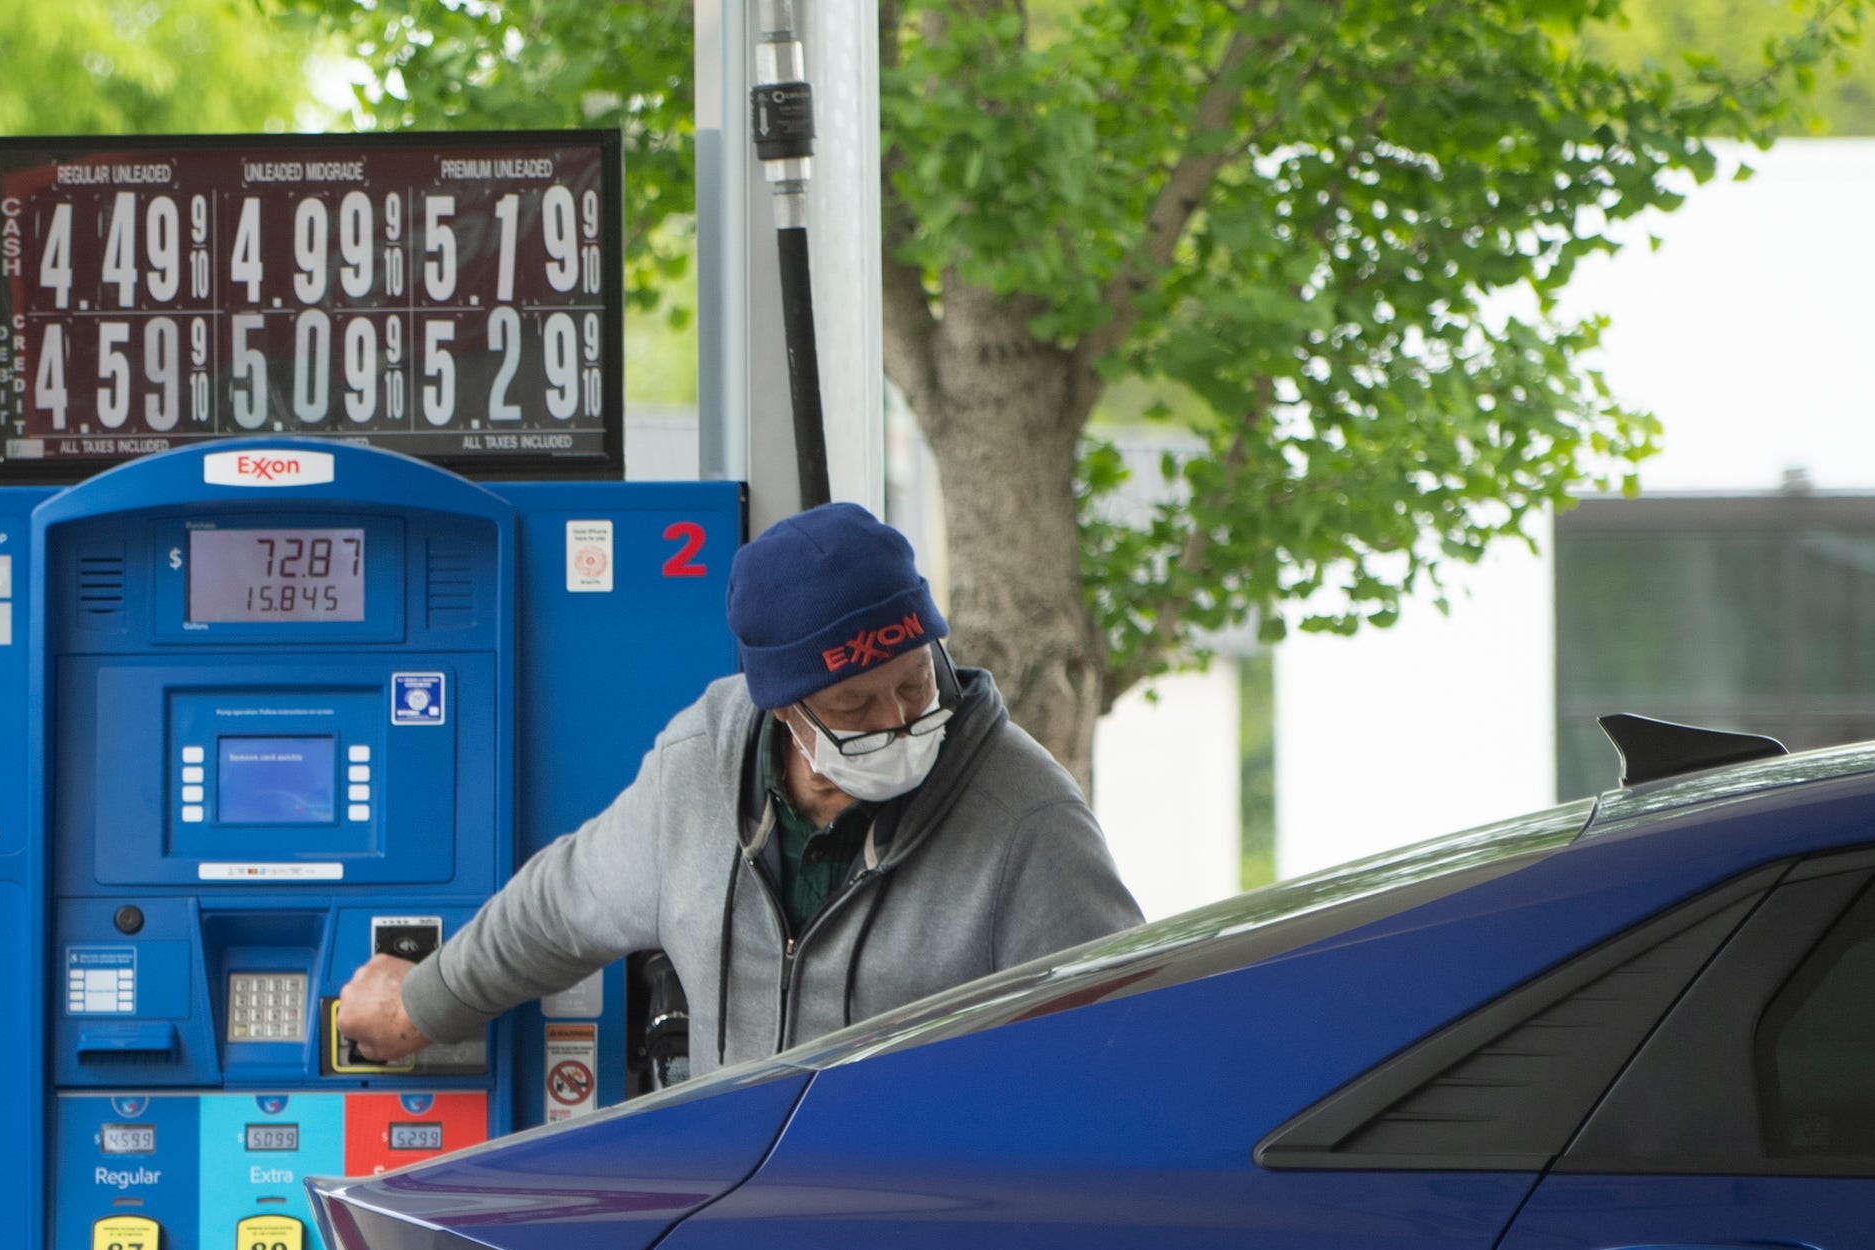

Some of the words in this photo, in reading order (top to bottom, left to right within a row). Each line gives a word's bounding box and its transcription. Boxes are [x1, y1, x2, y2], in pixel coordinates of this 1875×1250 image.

[57, 165, 110, 184] REGULAR
[112, 164, 172, 183] UNLEADED
[244, 163, 303, 182] UNLEADED
[305, 162, 364, 181] MIDGRADE
[441, 160, 492, 179] PREMIUM
[494, 159, 553, 178] UNLEADED
[1, 198, 22, 277] CASH
[40, 192, 179, 309] 4.49
[231, 191, 373, 307] 4.99
[425, 185, 578, 305] 5.19
[12, 315, 25, 435] CREDIT
[35, 317, 179, 434] 4.59
[232, 309, 377, 431] 5.09
[423, 306, 578, 429] 5.29
[60, 440, 81, 454] ALL
[83, 440, 115, 454] TAXES
[117, 439, 170, 453] INCLUDED
[462, 437, 482, 449] ALL
[485, 436, 518, 449] TAXES
[520, 435, 573, 448] INCLUDED
[237, 456, 300, 480] Exxon
[169, 547, 182, 570] $
[257, 538, 361, 578] 72.87
[662, 522, 707, 577] 2
[247, 586, 338, 611] 15.845
[822, 611, 925, 672] EXXON
[94, 1166, 162, 1190] Regular
[250, 1166, 294, 1185] Extra
